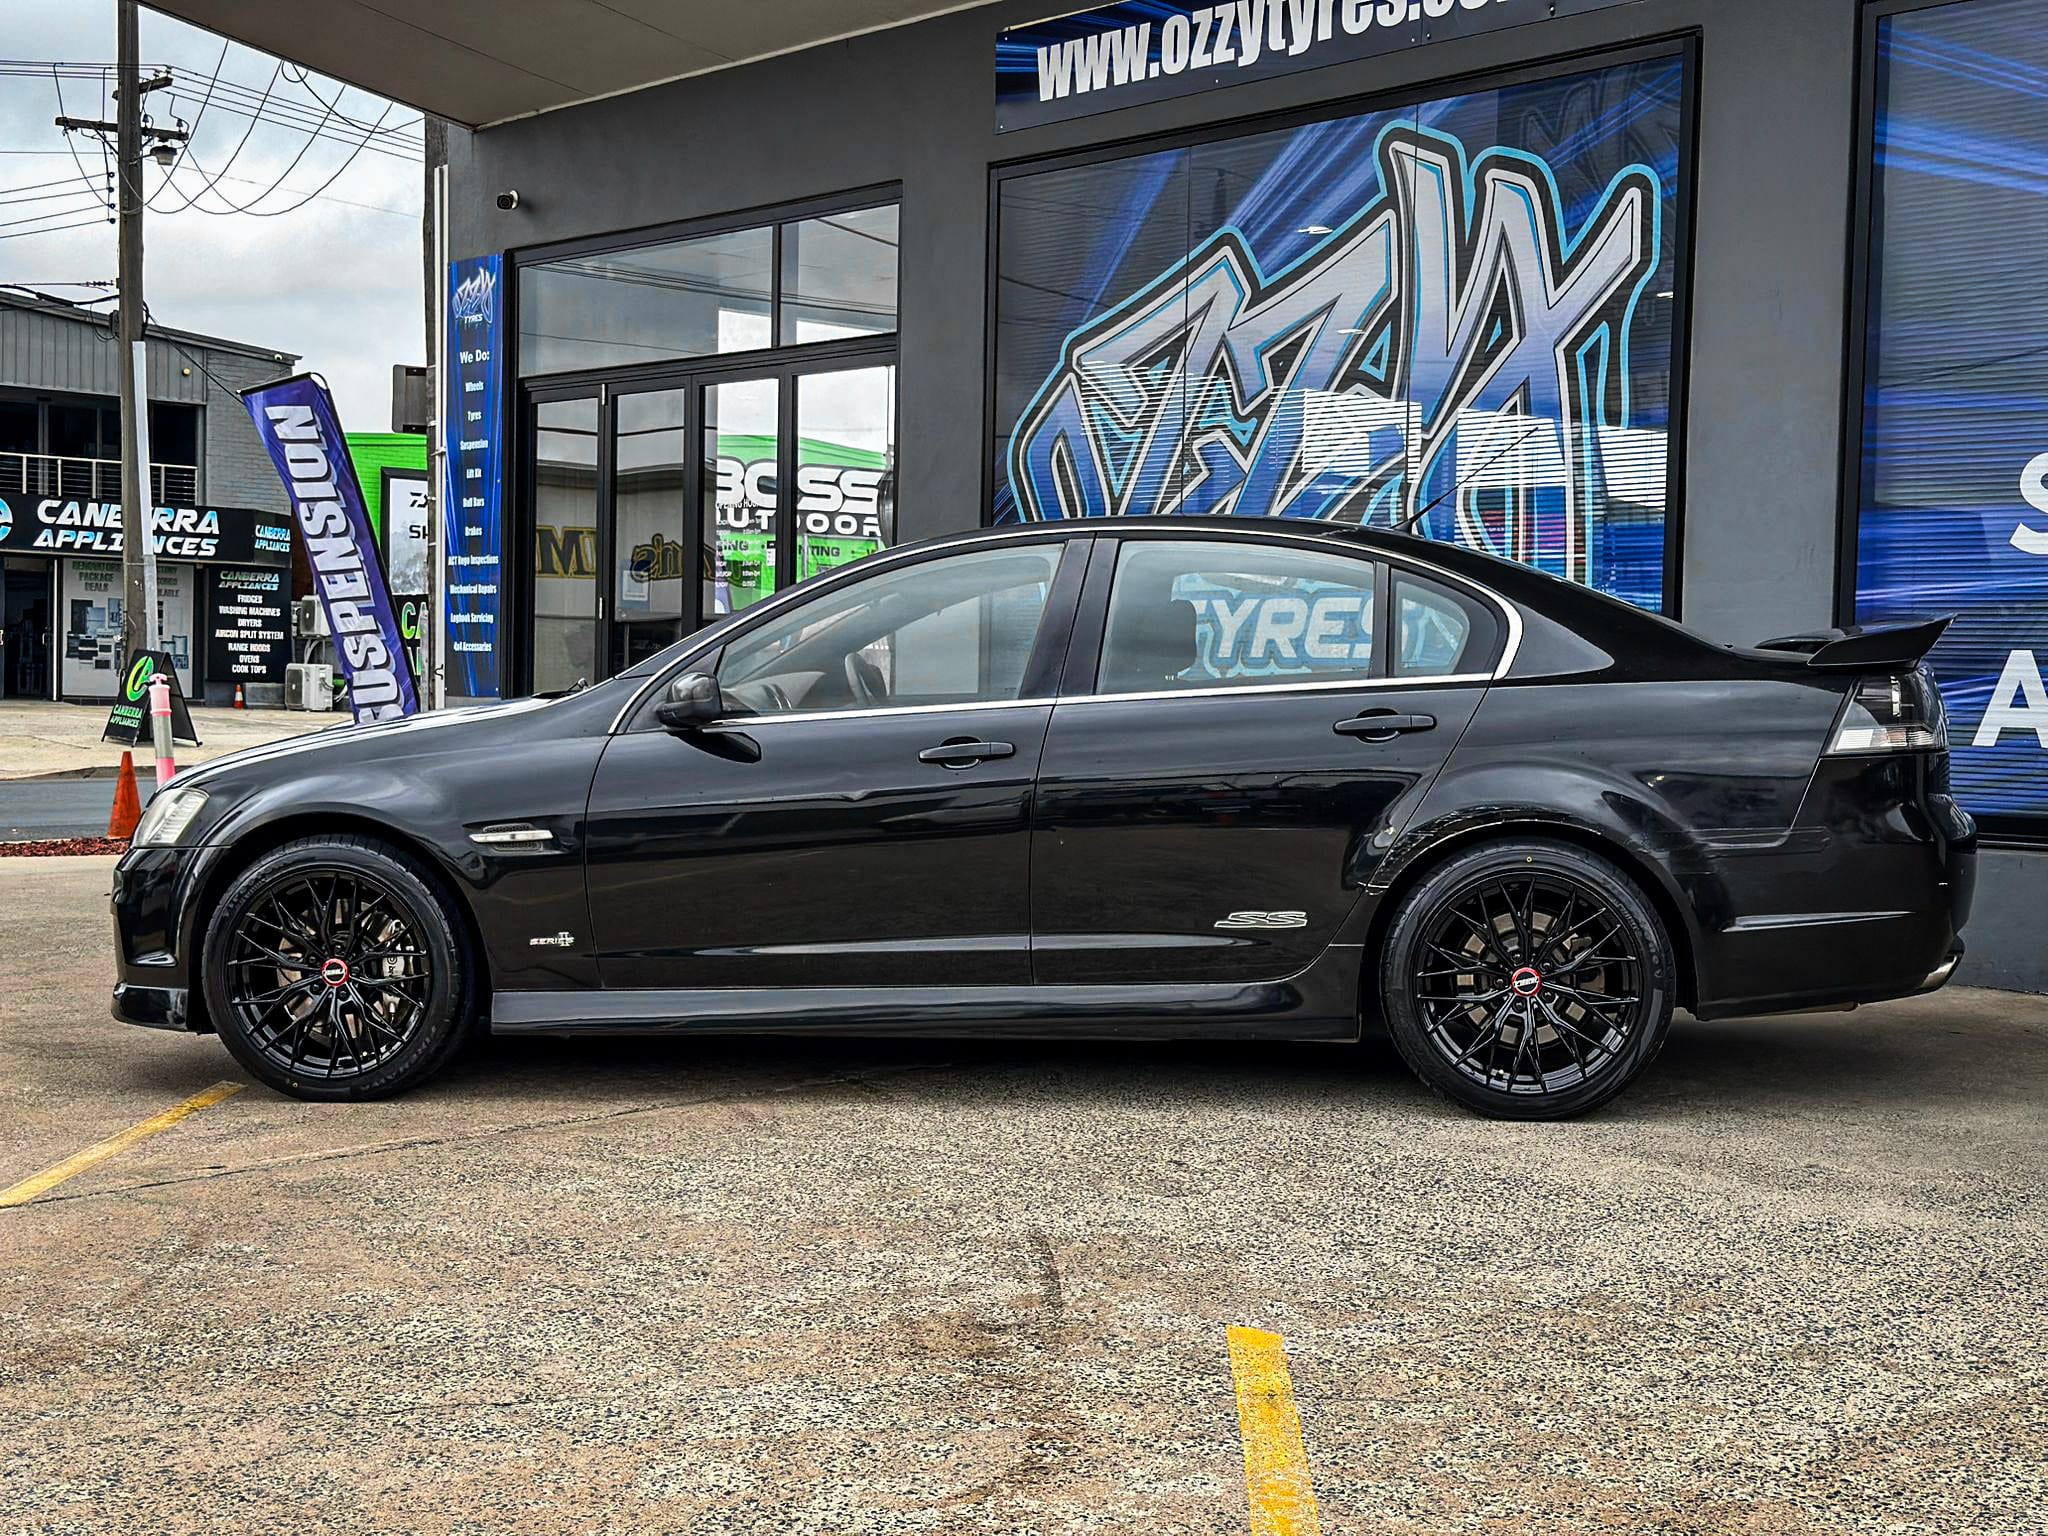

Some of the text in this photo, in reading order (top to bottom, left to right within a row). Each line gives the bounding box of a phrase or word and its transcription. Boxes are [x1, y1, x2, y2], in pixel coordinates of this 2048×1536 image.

[1038, 0, 1505, 101] www.ozzytyres.
[460, 349, 490, 364] We Do:
[467, 410, 482, 422] Tyres
[716, 456, 884, 515] BOSS
[36, 499, 220, 534] CANBRRA
[716, 507, 882, 537] UTOOR
[255, 524, 291, 541] CANBERRA
[465, 526, 483, 537] Brakes
[33, 528, 220, 557] APPLINCES
[254, 538, 291, 553] APPLIANCES
[220, 570, 280, 583] CANBERRA
[218, 581, 280, 591] APPLIANCES
[237, 594, 263, 604] FRIDGES
[219, 605, 281, 617] WASHING MACHINES
[237, 618, 263, 628] DRYERS
[215, 628, 284, 641] AIRCON SPLIT SYSTEM
[228, 642, 271, 653] RANGE HOODS
[239, 654, 260, 664] OVENS
[231, 664, 267, 675] COOK TOPS
[113, 703, 143, 719] CANBERRA
[110, 716, 140, 728] APPLIANCES
[1213, 911, 1308, 929] SS
